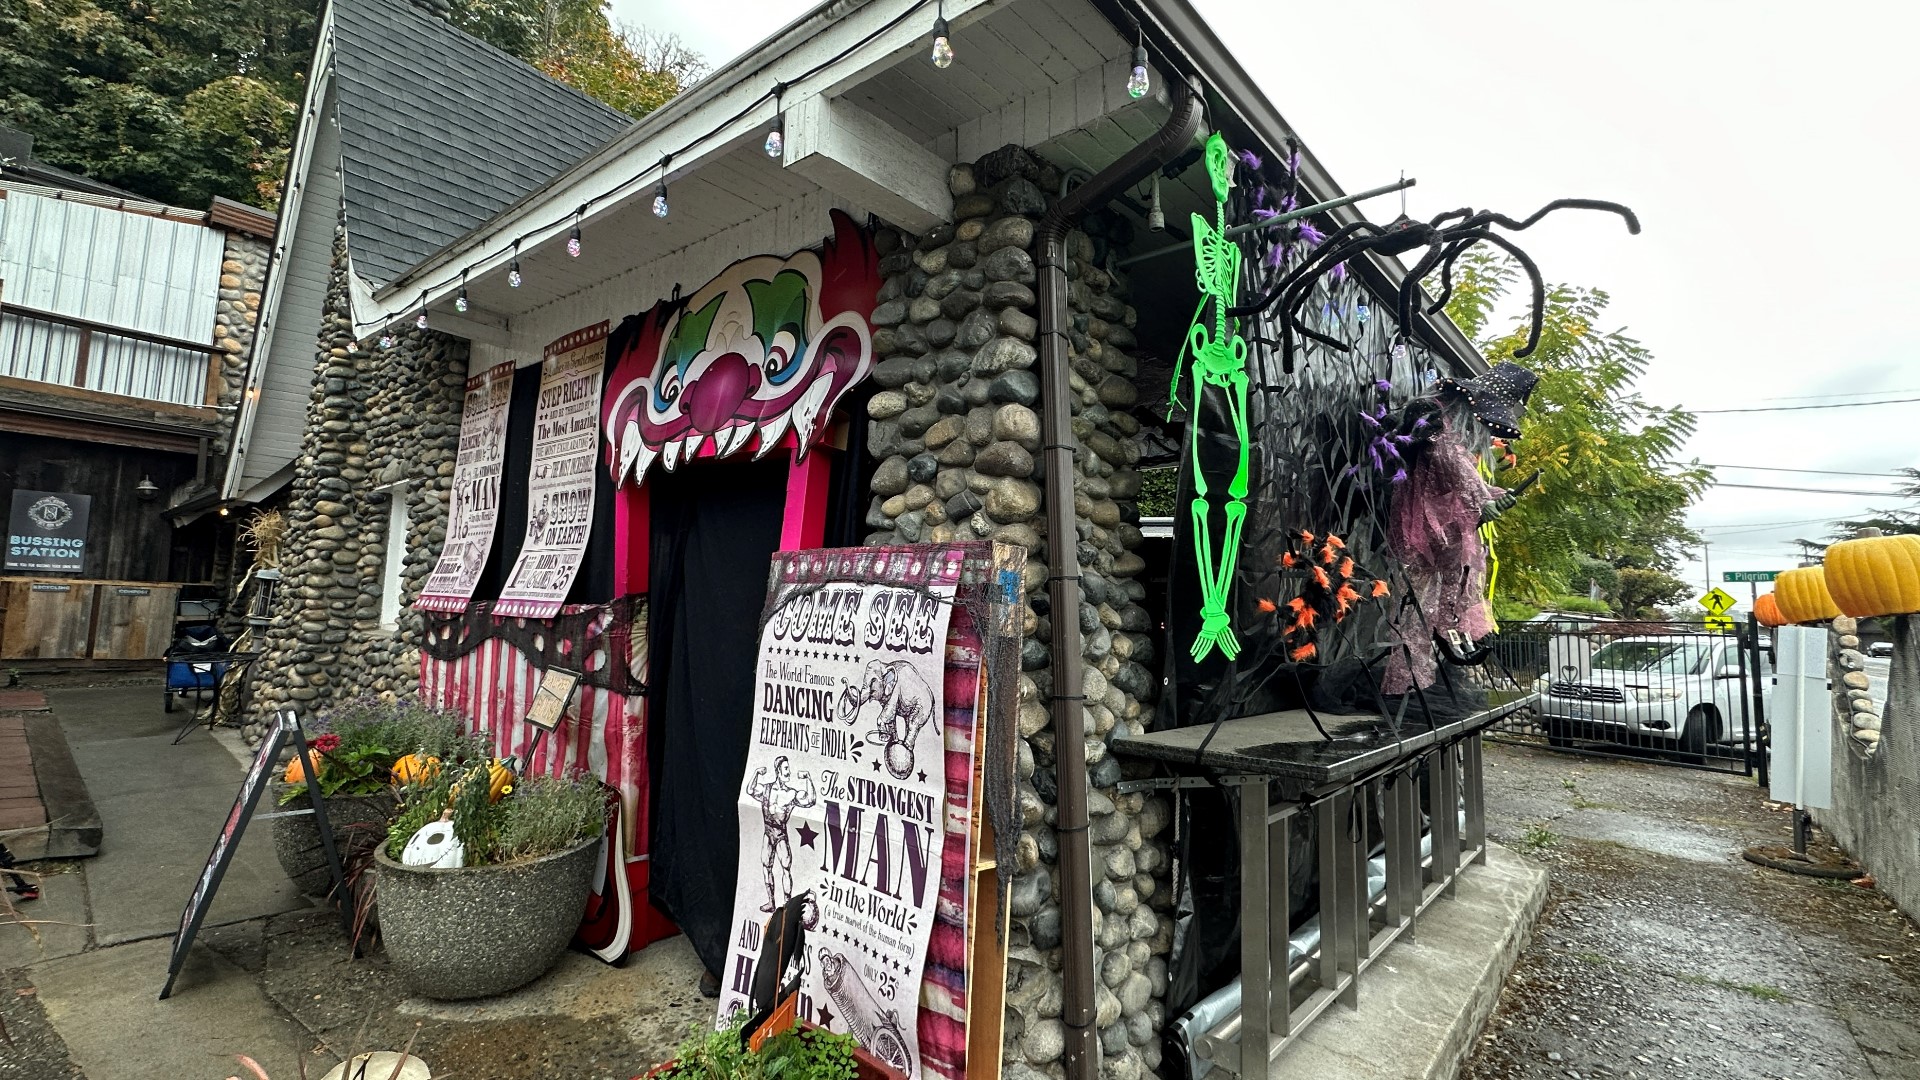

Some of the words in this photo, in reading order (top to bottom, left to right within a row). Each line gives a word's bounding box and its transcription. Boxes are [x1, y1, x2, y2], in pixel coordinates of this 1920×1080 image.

[540, 385, 562, 410] STEP
[563, 376, 590, 404] RIGHT
[538, 424, 551, 440] The
[552, 420, 568, 437] Most
[570, 411, 597, 433] Amazing
[470, 476, 499, 512] MAN
[550, 487, 592, 525] SHOW
[10, 535, 84, 548] BUSSING
[11, 546, 80, 559] STATION
[545, 527, 558, 546] ON
[556, 525, 587, 545] EARTH!
[1735, 572, 1769, 582] Pilgrim
[773, 589, 863, 647] COME
[864, 590, 941, 654] SEE
[765, 660, 778, 679] The
[779, 663, 803, 683] World
[804, 665, 835, 687] Famous
[763, 682, 834, 723] DANCING
[759, 717, 810, 753] ELEPHANTS
[810, 733, 821, 748] OF
[821, 727, 848, 760] INDIA
[820, 769, 846, 800] The
[847, 775, 935, 824] STRONGEST
[819, 800, 935, 909] MAN
[829, 880, 843, 908] in
[845, 887, 866, 915] the
[867, 893, 908, 932] World
[738, 919, 760, 952] AND
[824, 904, 831, 920] (a
[832, 907, 844, 922] true
[845, 915, 862, 931] marvel
[862, 920, 870, 934] of
[869, 923, 877, 938] the
[878, 929, 897, 948] human
[897, 936, 915, 960] form)
[863, 964, 879, 983] ONLY
